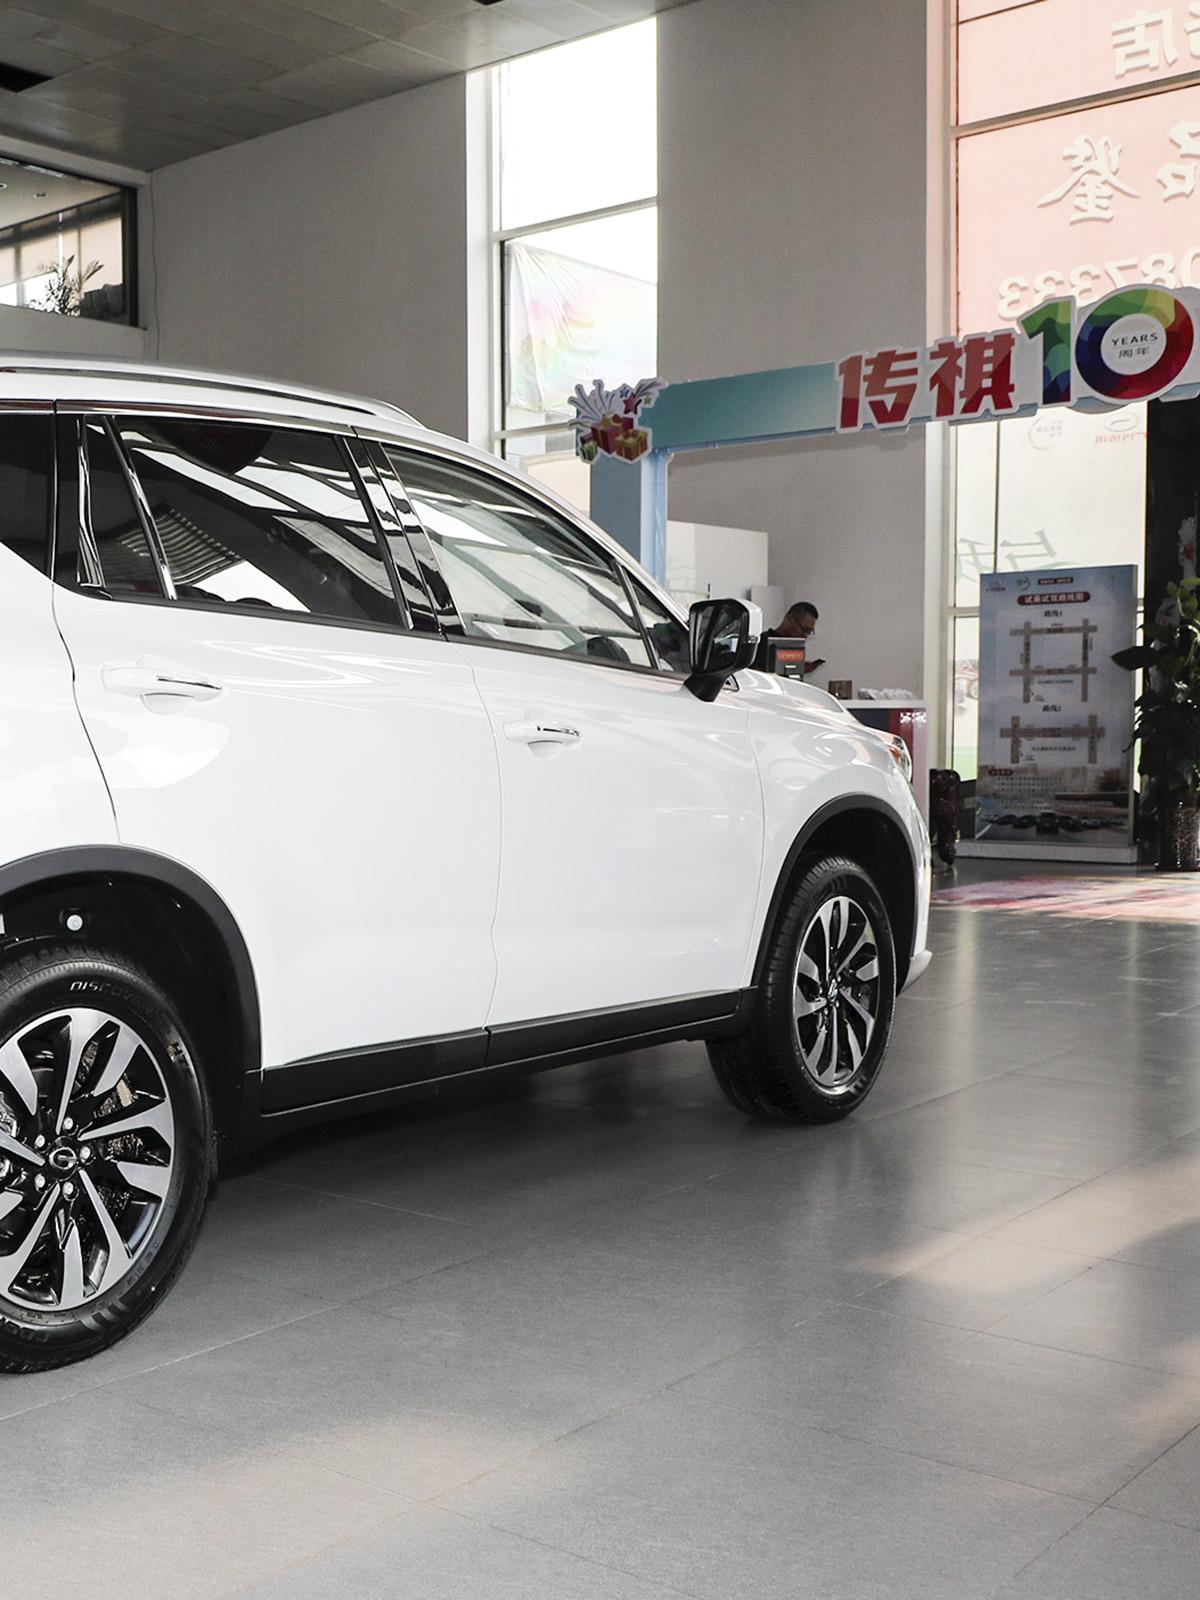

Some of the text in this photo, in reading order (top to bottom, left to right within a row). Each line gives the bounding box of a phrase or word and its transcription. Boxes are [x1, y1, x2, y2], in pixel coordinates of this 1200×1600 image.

[1111, 332, 1159, 347] YEARS
[838, 288, 1195, 429] 传祺 10
[1118, 347, 1150, 359] 周年
